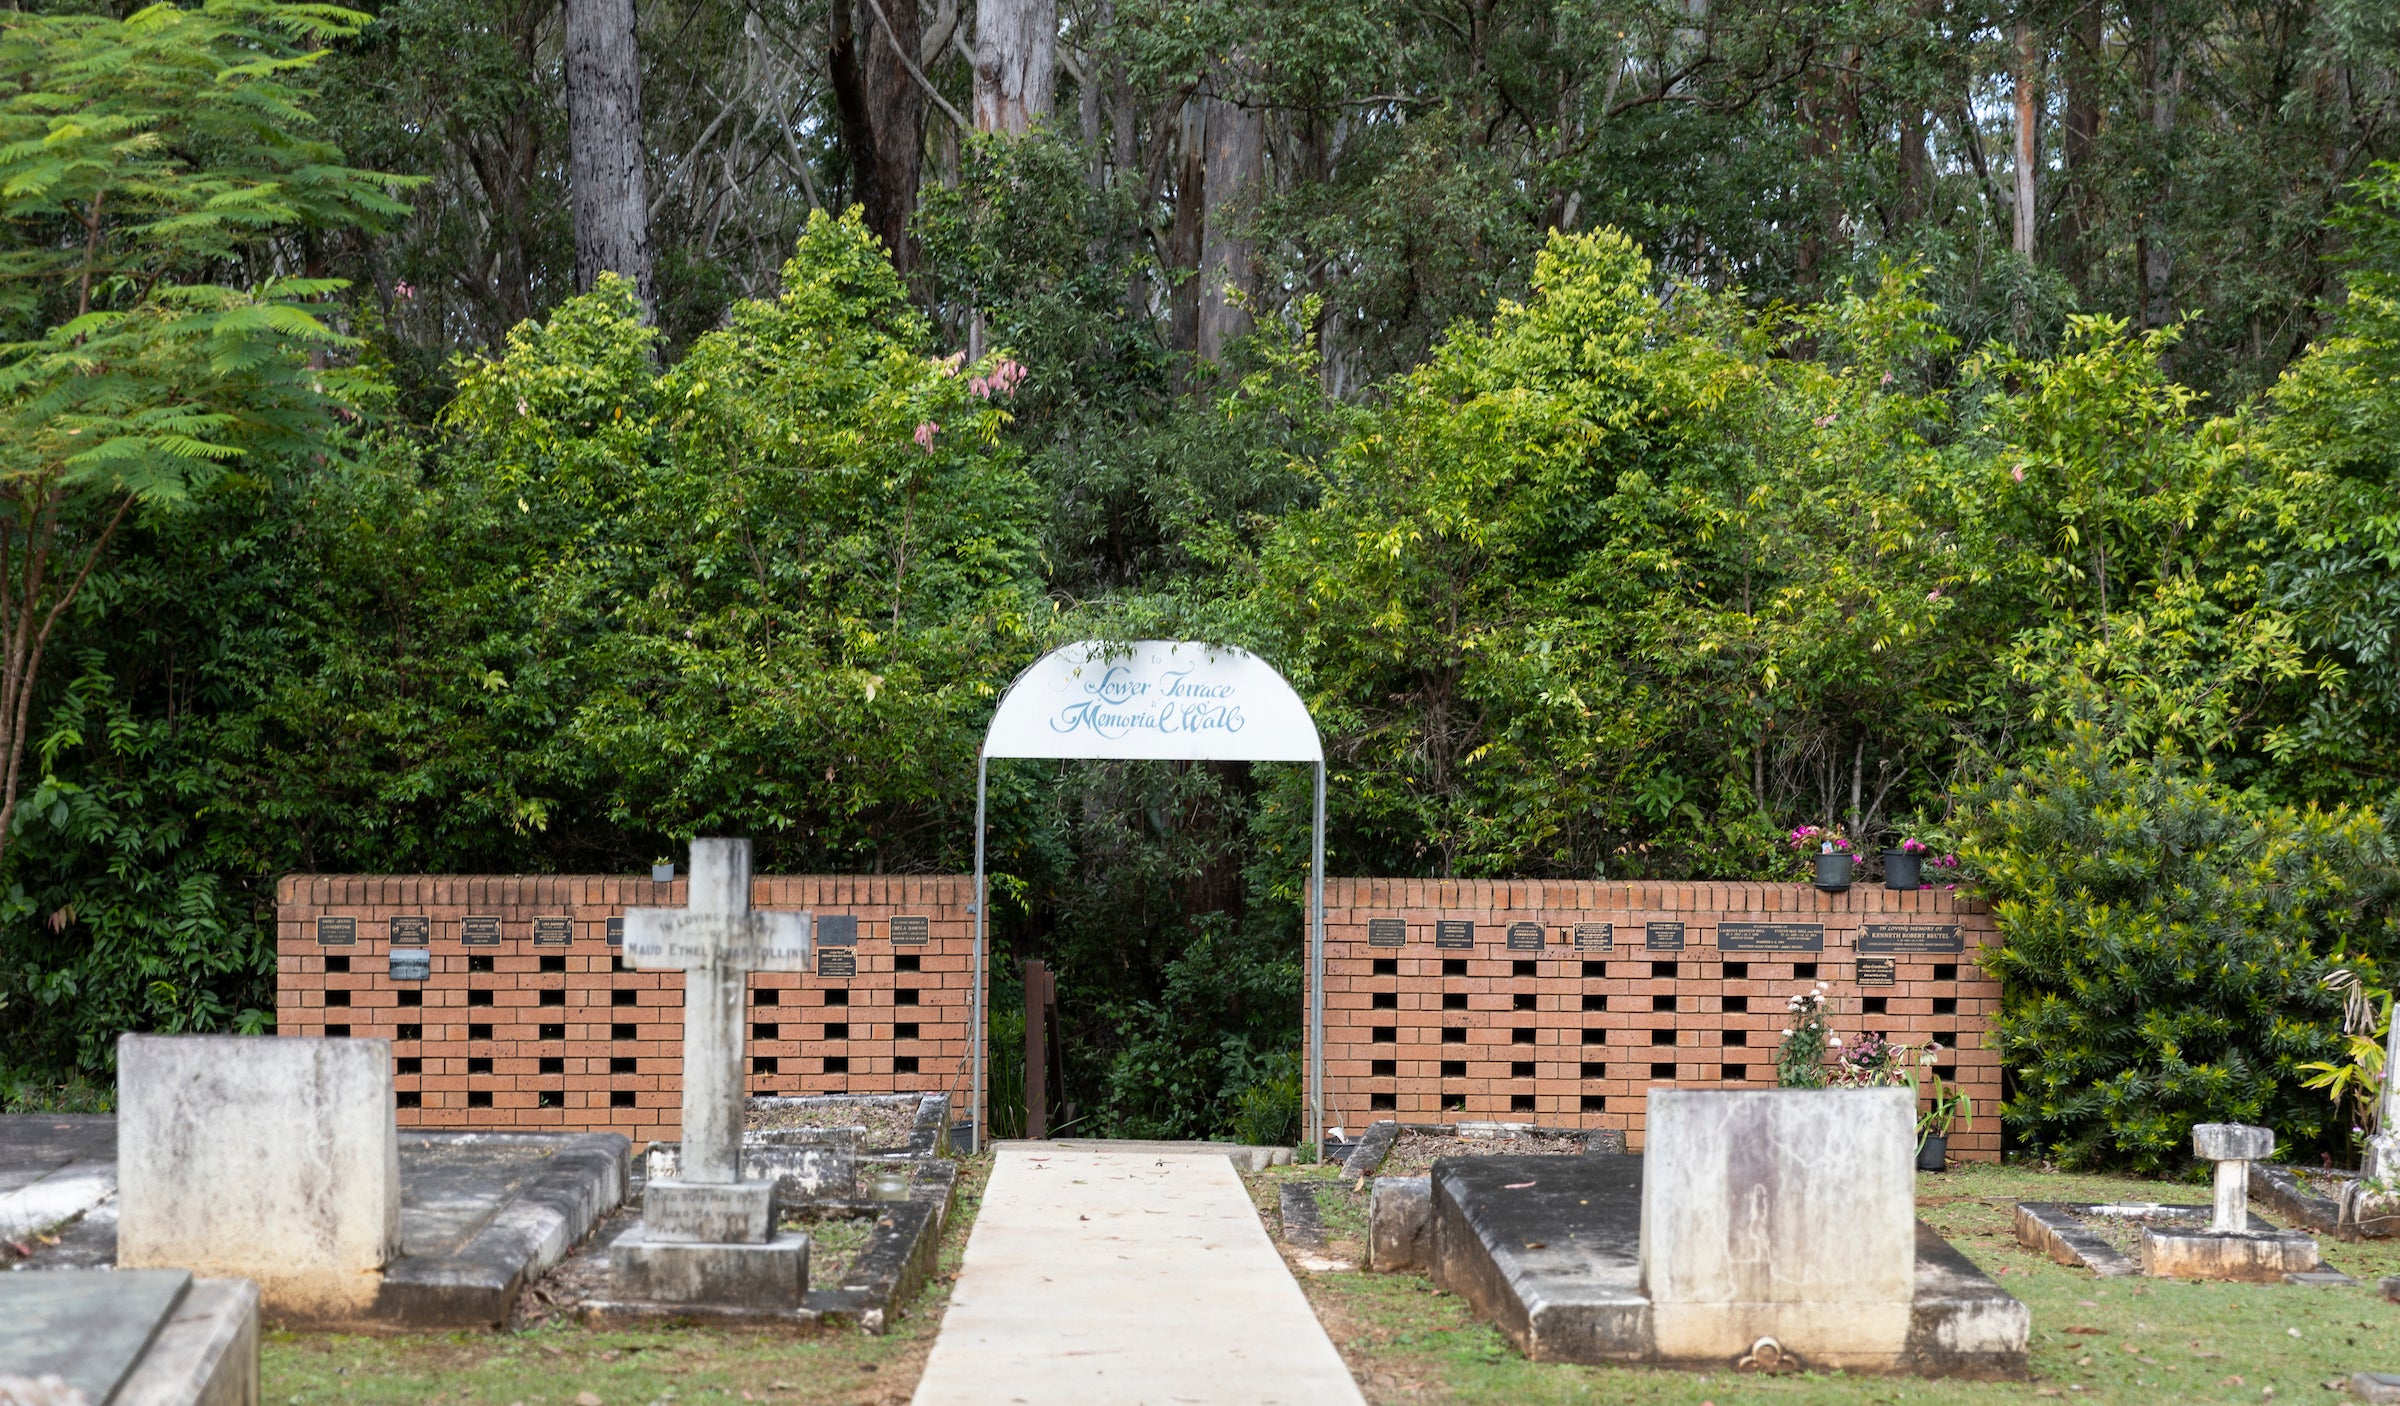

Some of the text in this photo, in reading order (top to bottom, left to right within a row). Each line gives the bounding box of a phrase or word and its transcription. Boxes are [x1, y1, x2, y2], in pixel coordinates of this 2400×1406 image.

[1084, 660, 1235, 705] Lower Terrace
[1050, 701, 1245, 740] Memorial Wall
[677, 913, 721, 929] LOVING
[629, 943, 662, 956] MAUD
[669, 943, 709, 957] ETHEL
